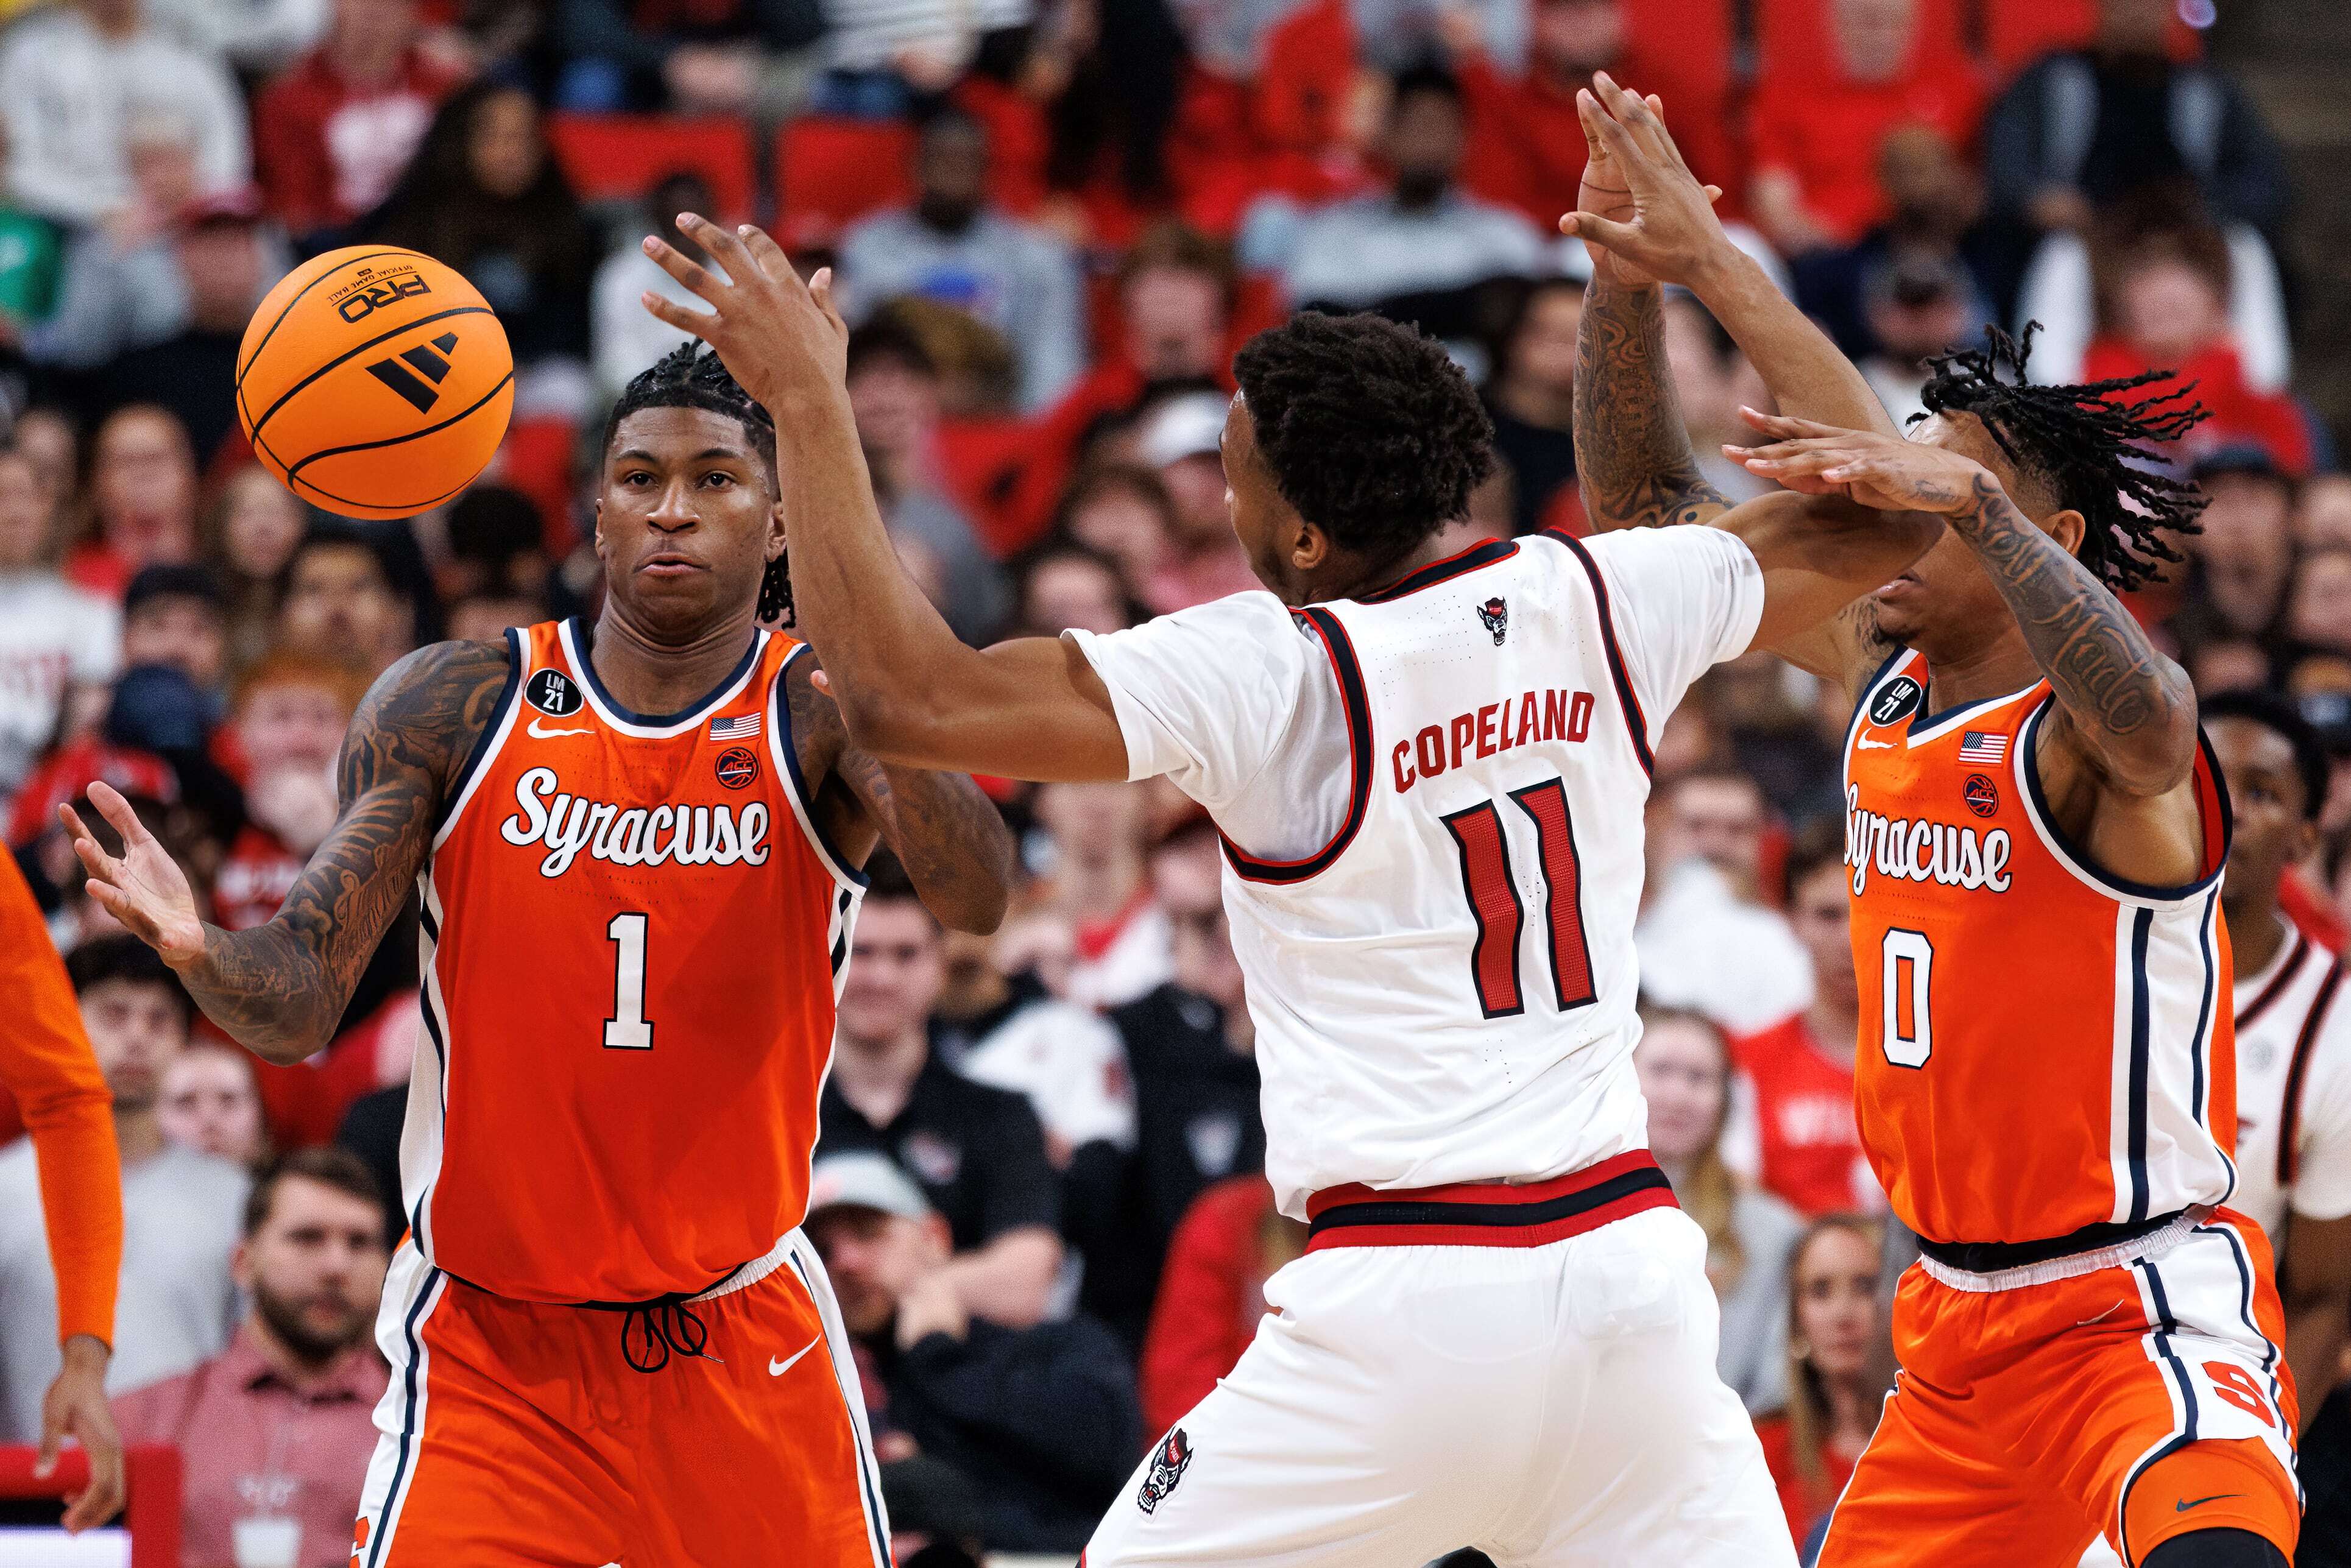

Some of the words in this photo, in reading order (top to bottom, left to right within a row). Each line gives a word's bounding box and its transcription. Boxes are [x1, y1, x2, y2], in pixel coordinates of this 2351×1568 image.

[339, 275, 431, 323] PRO
[543, 688, 564, 712] 21
[546, 673, 565, 692] LM
[1875, 696, 1900, 721] 21
[1892, 680, 1914, 701] LM
[1391, 689, 1594, 794] COPELAND
[500, 766, 771, 877] Syracuse
[1438, 775, 1598, 1020] 11
[603, 911, 654, 1050] 1
[1882, 926, 1934, 1070] 0
